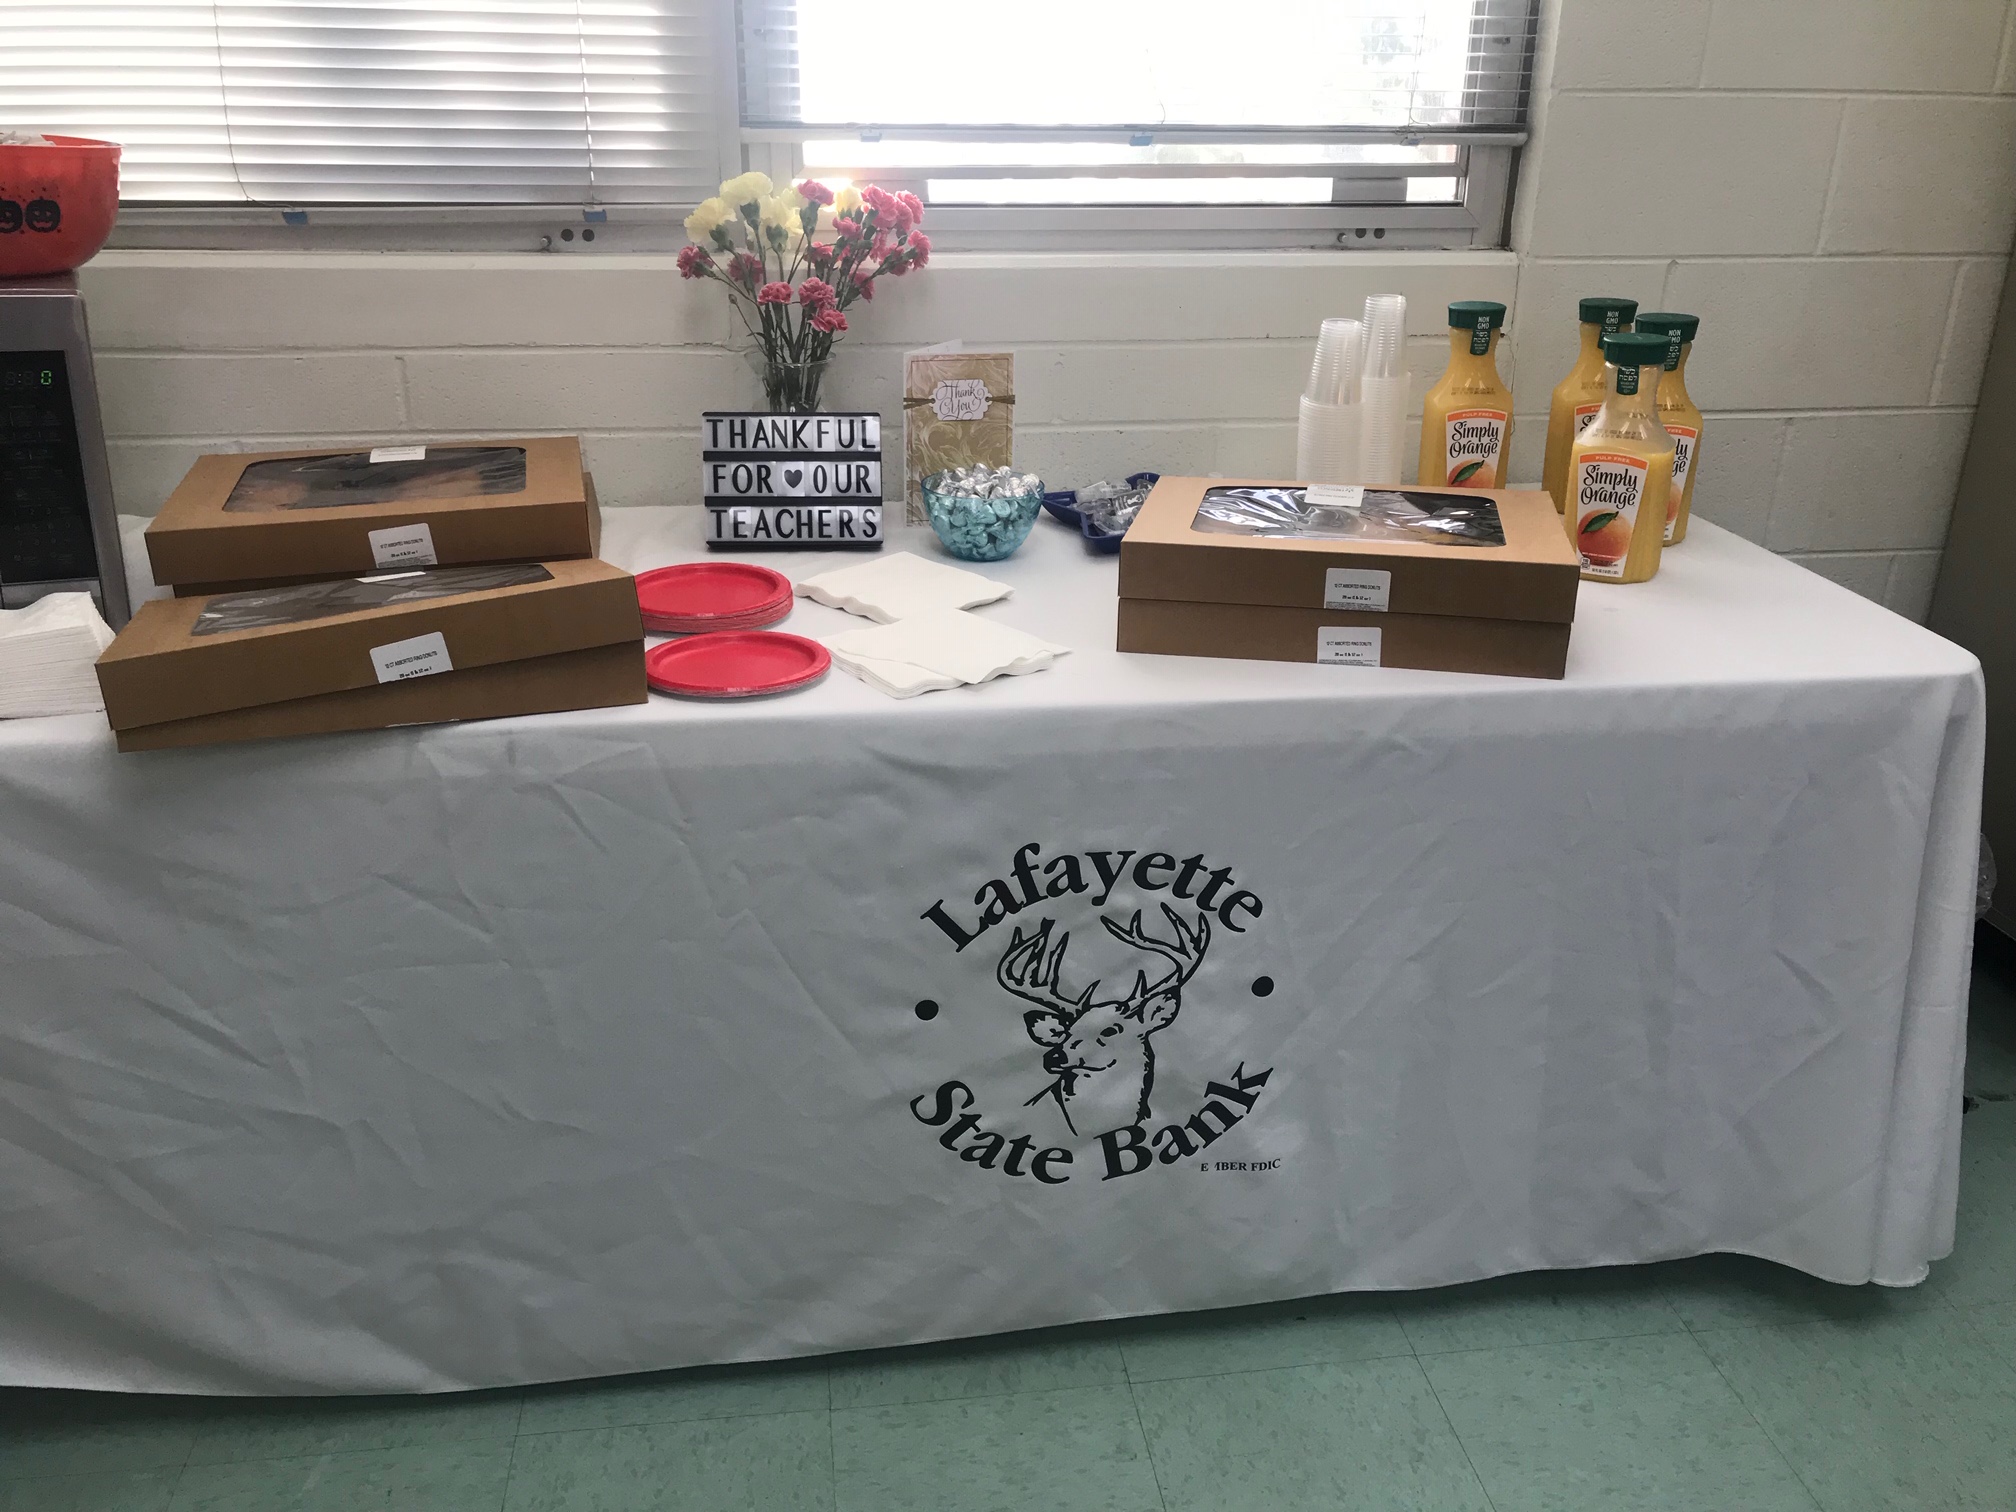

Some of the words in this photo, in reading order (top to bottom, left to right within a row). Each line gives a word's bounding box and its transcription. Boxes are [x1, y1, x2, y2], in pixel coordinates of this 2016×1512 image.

[1477, 322, 1489, 330] GMO
[936, 380, 985, 400] Thank
[940, 397, 981, 420] You
[706, 419, 876, 448] THANKFUL
[1451, 421, 1499, 442] Simply
[1449, 440, 1498, 458] Orange
[712, 464, 774, 494] FOR
[813, 464, 872, 494] OUR
[1583, 464, 1638, 493] Simply
[1580, 486, 1636, 509] Orange
[710, 508, 877, 539] TEACHERS
[920, 842, 1264, 952] Lafayette
[910, 1080, 1074, 1184] State
[1093, 1061, 1274, 1181] Bank
[1251, 1158, 1281, 1172] FDIC
